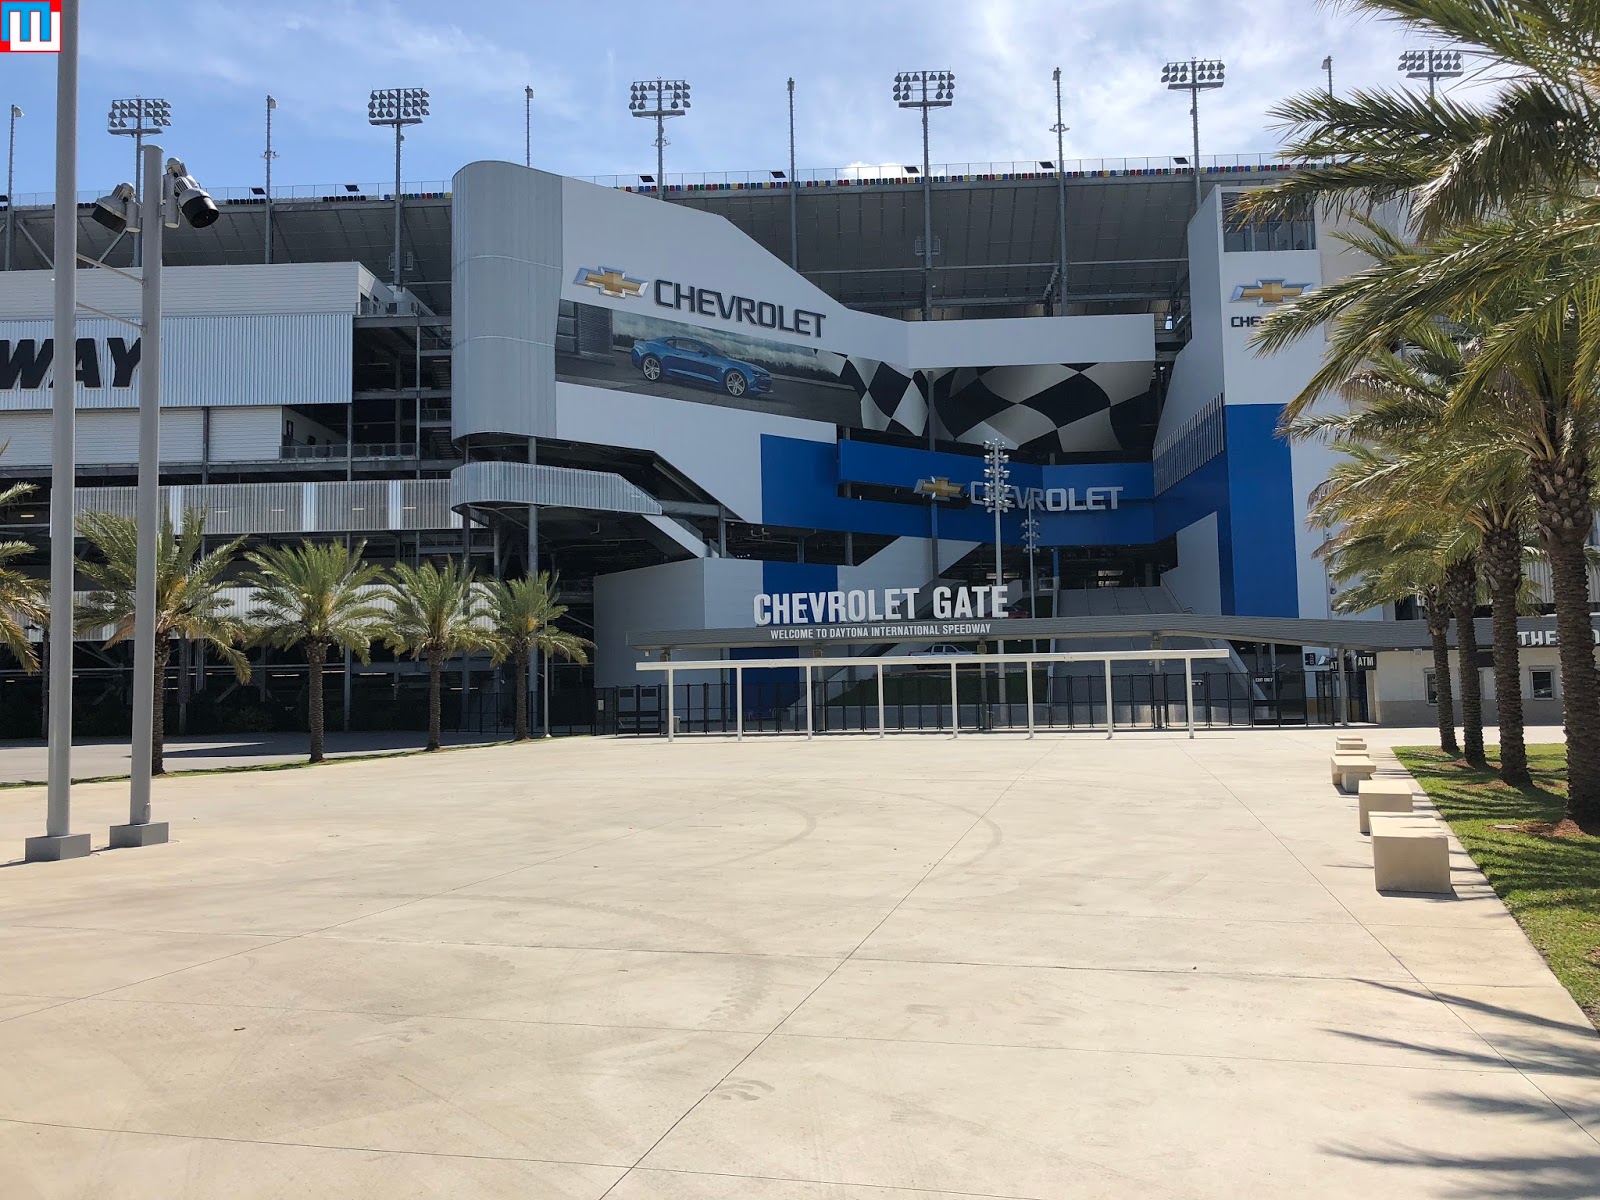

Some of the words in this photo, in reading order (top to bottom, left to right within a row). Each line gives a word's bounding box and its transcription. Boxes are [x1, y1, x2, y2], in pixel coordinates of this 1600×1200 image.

[654, 279, 826, 338] CHEVROLET
[971, 481, 1124, 511] CEVROLET
[754, 588, 920, 625] CHEVROLET
[932, 586, 1009, 619] GATE
[770, 629, 814, 640] WELCOME
[816, 628, 827, 639] TO
[830, 627, 869, 639] DAYTONA
[871, 625, 940, 637] INTERNATIONAL
[942, 623, 991, 635] SPEEDWAY
[1357, 656, 1374, 667] ATM
